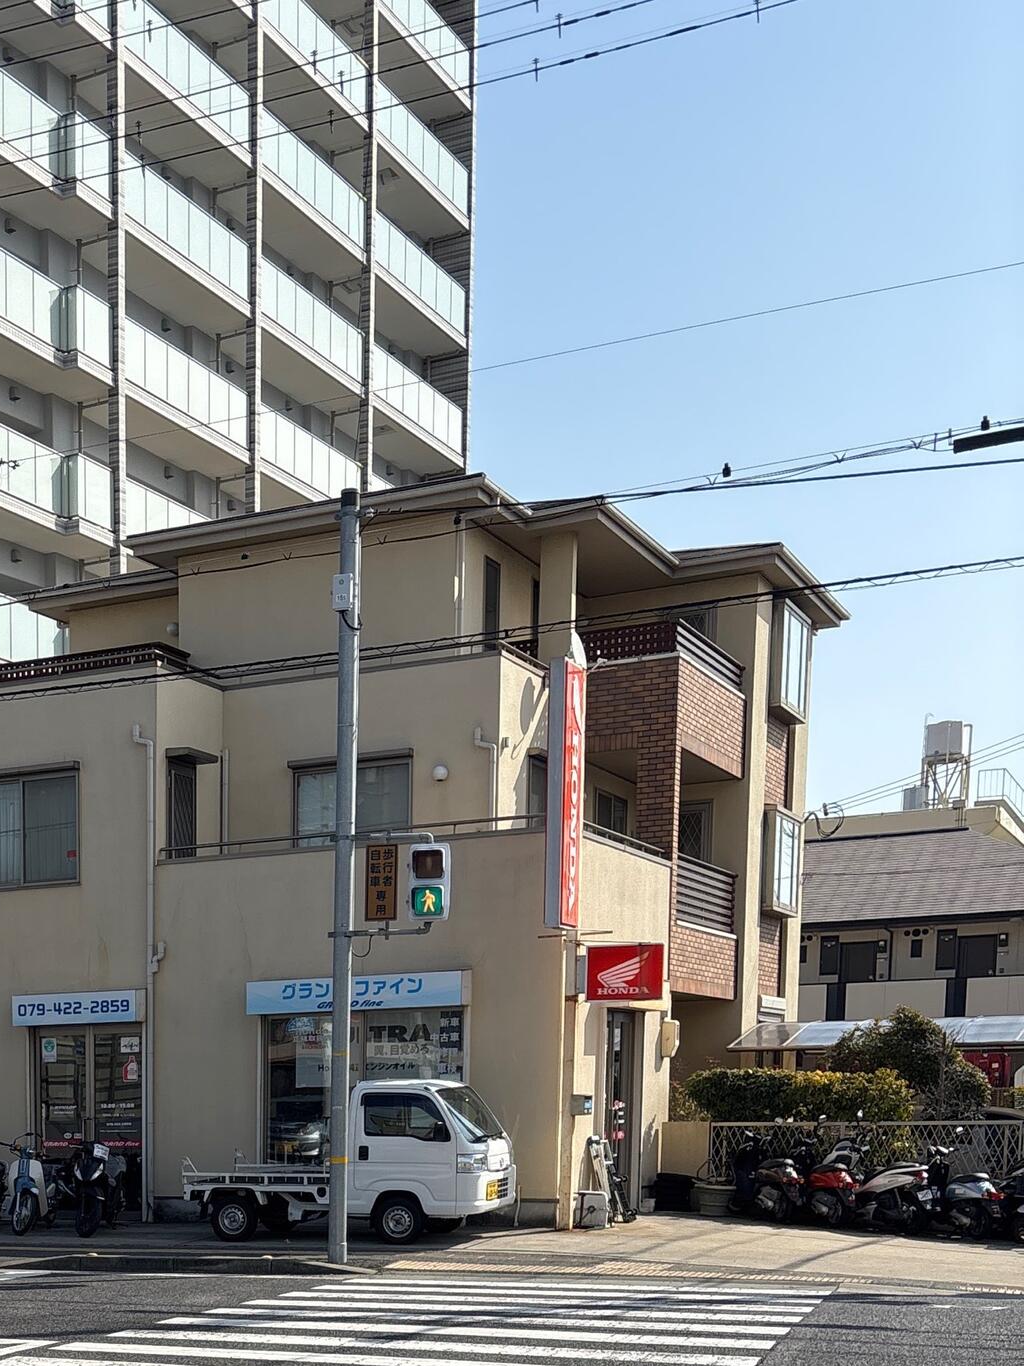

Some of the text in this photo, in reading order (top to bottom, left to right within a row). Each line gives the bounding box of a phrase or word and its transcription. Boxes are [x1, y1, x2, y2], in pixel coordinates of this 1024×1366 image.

[568, 732, 580, 911] HONDA
[369, 849, 381, 887] 自転車
[382, 848, 394, 887] 歩行者
[375, 890, 386, 917] 専用
[282, 978, 422, 1000] グランファイン
[596, 986, 651, 996] HONDA
[18, 999, 130, 1017] 079-422-2859
[317, 999, 385, 1009] GRD fine
[439, 1017, 460, 1027] 新車
[429, 1031, 460, 1045] 中古車
